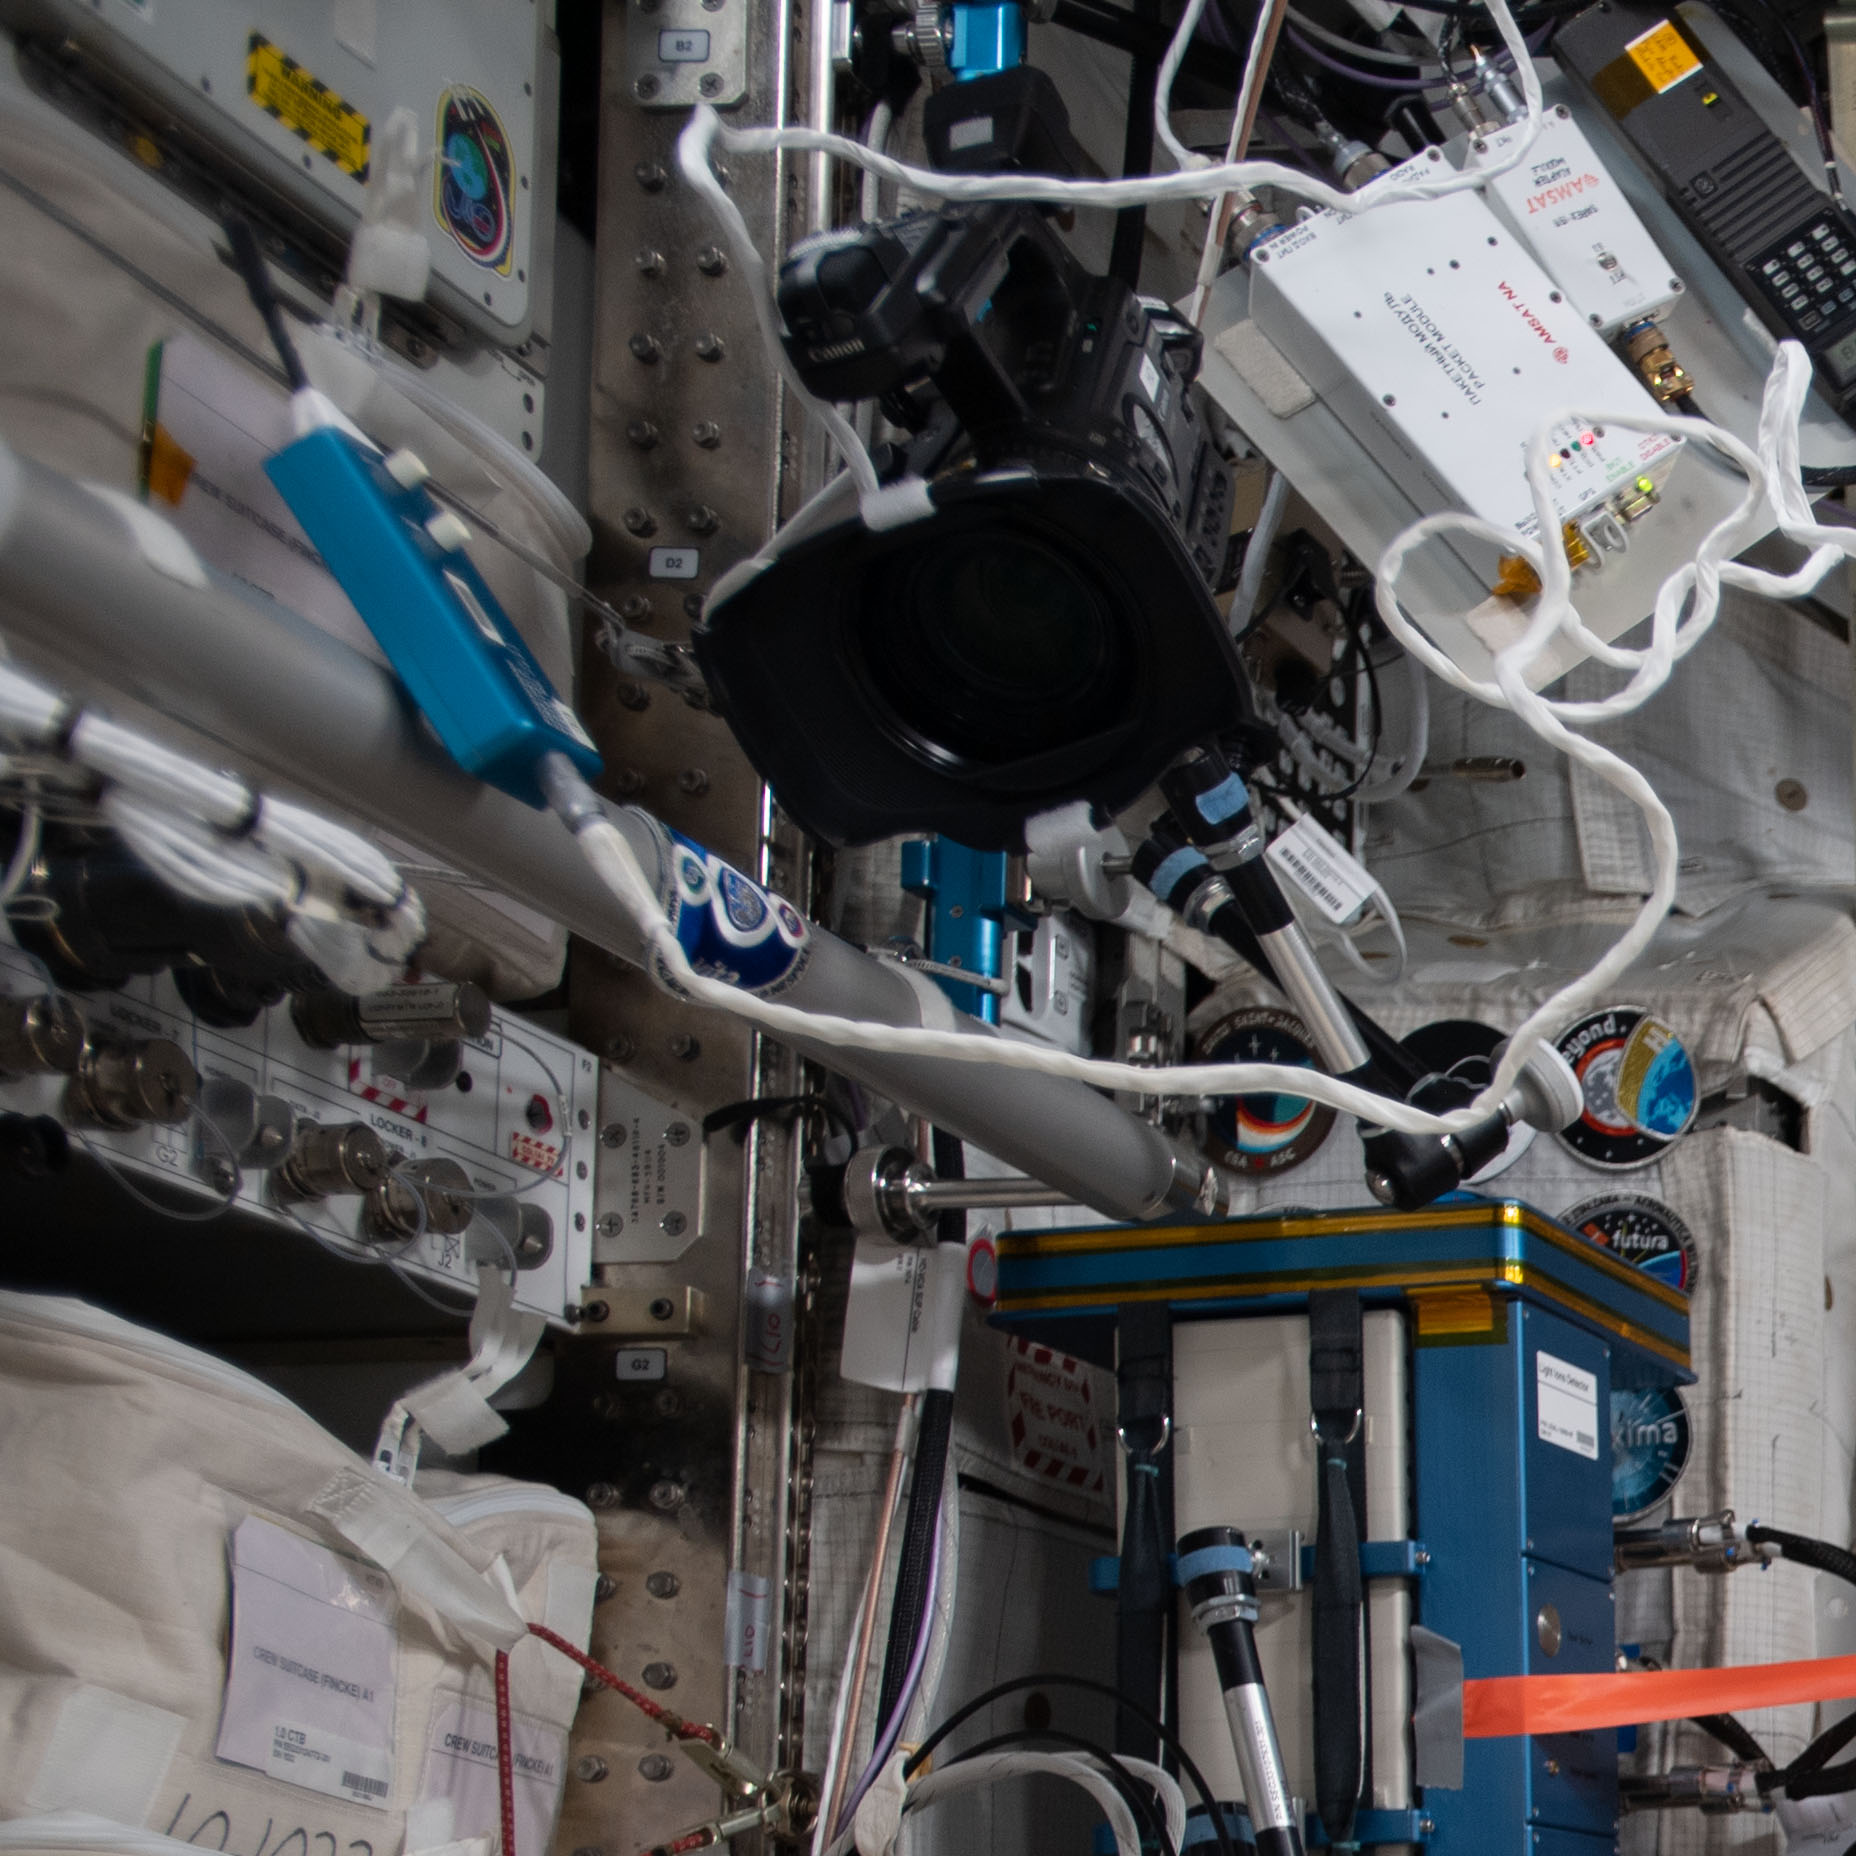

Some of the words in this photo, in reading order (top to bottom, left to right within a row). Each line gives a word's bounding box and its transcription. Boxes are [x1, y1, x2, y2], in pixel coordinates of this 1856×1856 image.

[676, 40, 693, 52] B2
[1526, 176, 1585, 215] AMSAT
[1280, 225, 1311, 247] POWER
[1498, 280, 1518, 303] NA
[1383, 290, 1428, 346] МОДУЛЬ
[1400, 292, 1446, 343] MODULE
[1514, 302, 1559, 347] AMSAT
[808, 336, 864, 362] Canon
[1422, 341, 1483, 407] ПАКЕТНЫЙ
[1443, 340, 1487, 390] PACKET
[665, 557, 683, 568] D2
[370, 1112, 413, 1144] LOCKER
[156, 1143, 180, 1168] G2
[1612, 1226, 1669, 1252] futura
[436, 1252, 453, 1270] J2
[631, 1359, 650, 1370] G2
[1046, 1404, 1084, 1432] PORT
[252, 1645, 278, 1668] CREW
[278, 1654, 320, 1685] SUITCASE
[286, 1728, 307, 1746] CTB
[444, 1732, 470, 1750] CREW
